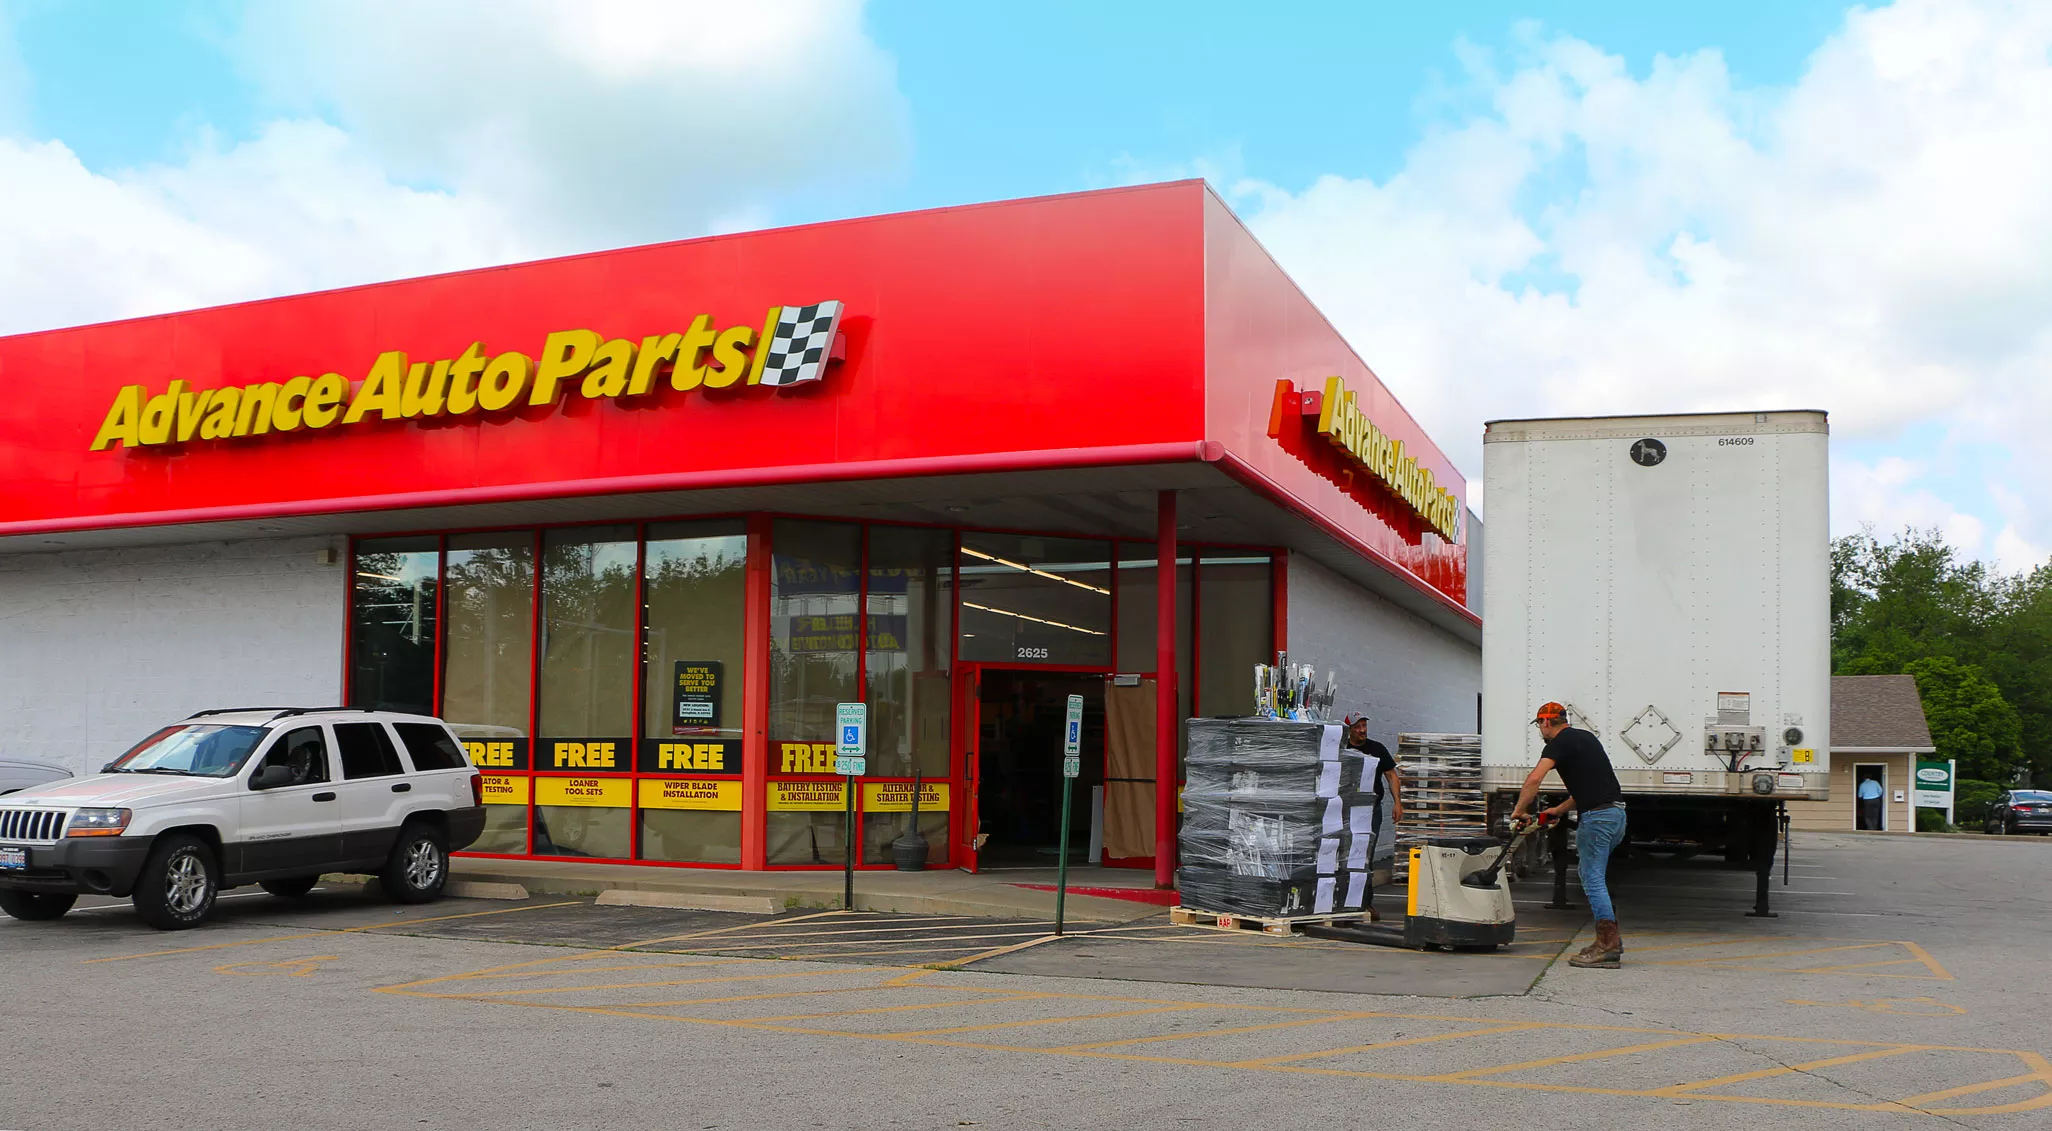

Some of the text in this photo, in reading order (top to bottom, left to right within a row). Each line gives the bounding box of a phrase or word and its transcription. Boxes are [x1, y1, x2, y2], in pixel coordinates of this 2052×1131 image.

[89, 313, 755, 451] Advance Auto Parts
[1718, 437, 1754, 446] 614609
[1319, 375, 1453, 539] Advance Auto Parts
[1017, 647, 1048, 658] 2625
[554, 743, 615, 767] FREE
[658, 743, 724, 769] FREE
[781, 744, 837, 773] FREE
[853, 761, 864, 771] FINE
[664, 782, 718, 790] WIPER BLADE
[777, 782, 842, 792] BATTERY TESTING
[882, 783, 934, 793] ALTERNAOR &
[586, 788, 603, 796] SETS
[663, 790, 718, 799] INSTALLATION
[780, 792, 840, 802] & INSTALLATION
[876, 793, 940, 802] STARTER TSTING
